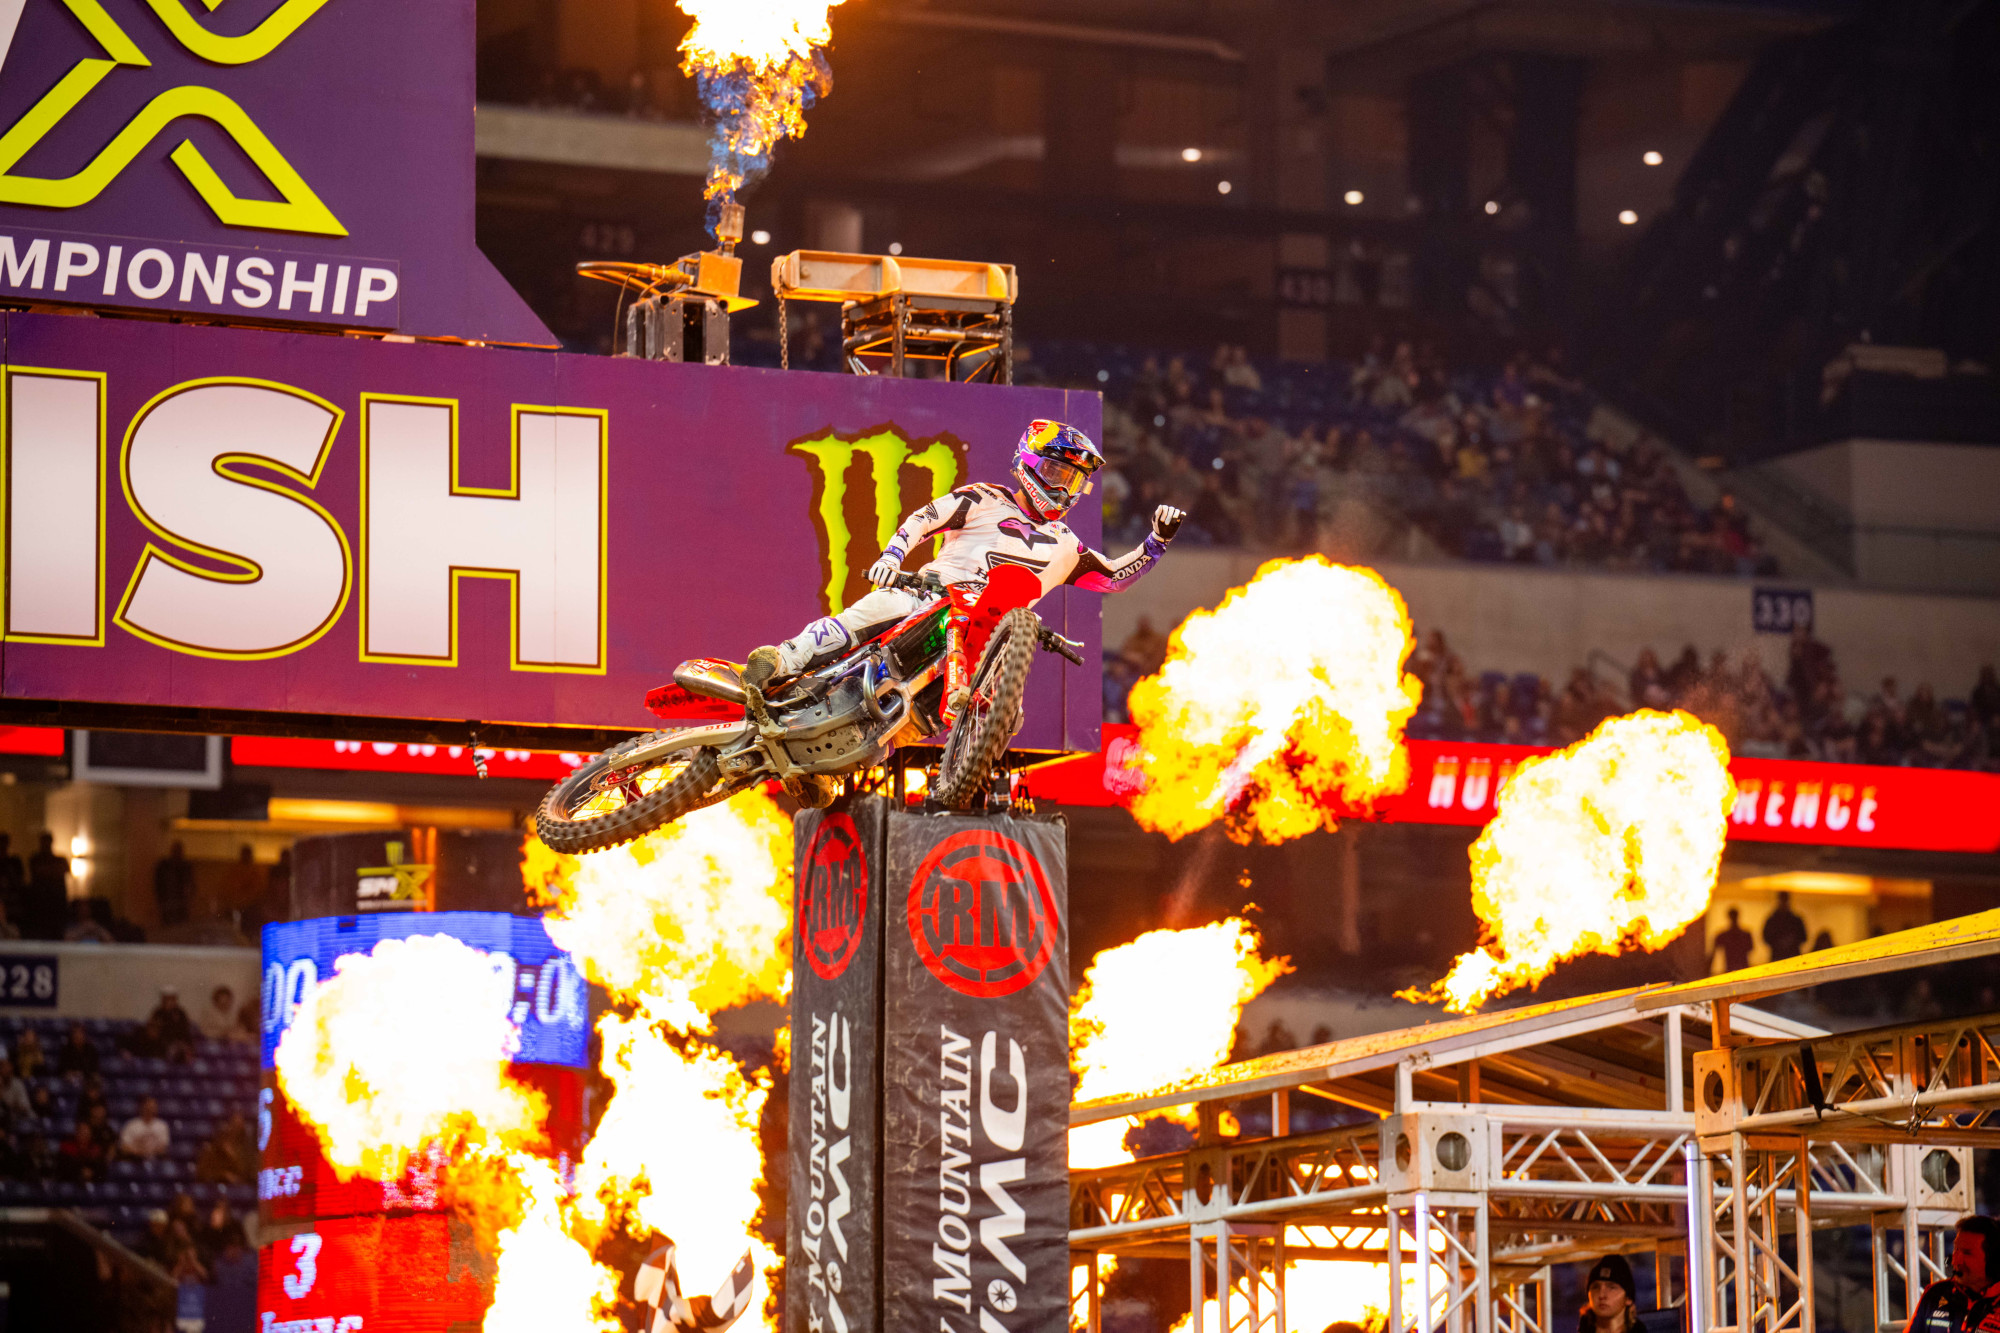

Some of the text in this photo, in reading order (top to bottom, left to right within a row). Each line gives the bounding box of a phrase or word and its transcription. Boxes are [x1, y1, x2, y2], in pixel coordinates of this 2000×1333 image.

[1757, 594, 1811, 625] 330
[801, 1012, 828, 1298] MOUNTAIN
[933, 1023, 972, 1315] MOUNTAIN
[283, 1232, 323, 1300] 3
